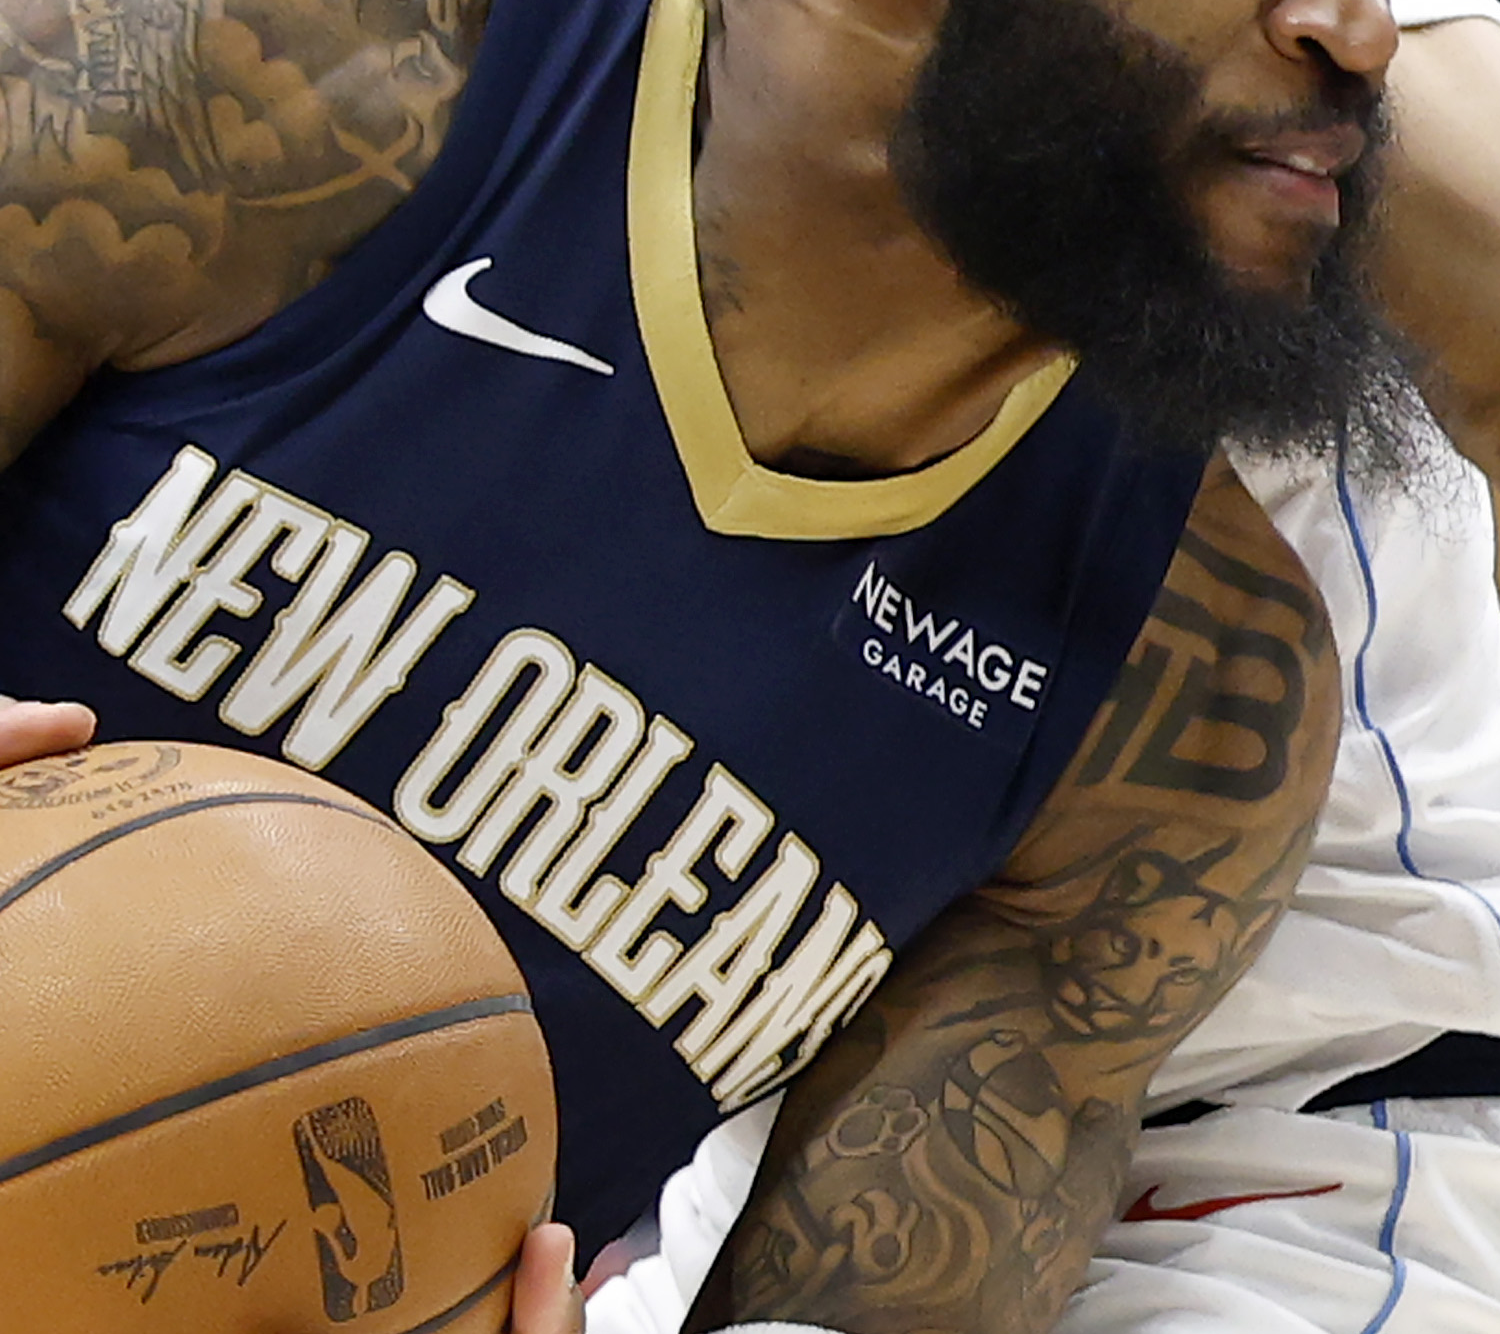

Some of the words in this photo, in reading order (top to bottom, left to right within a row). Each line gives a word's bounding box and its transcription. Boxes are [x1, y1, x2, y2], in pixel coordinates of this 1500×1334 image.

[62, 444, 476, 771] NEW
[852, 559, 1048, 711] NEWAGE
[862, 637, 988, 730] GARAGE
